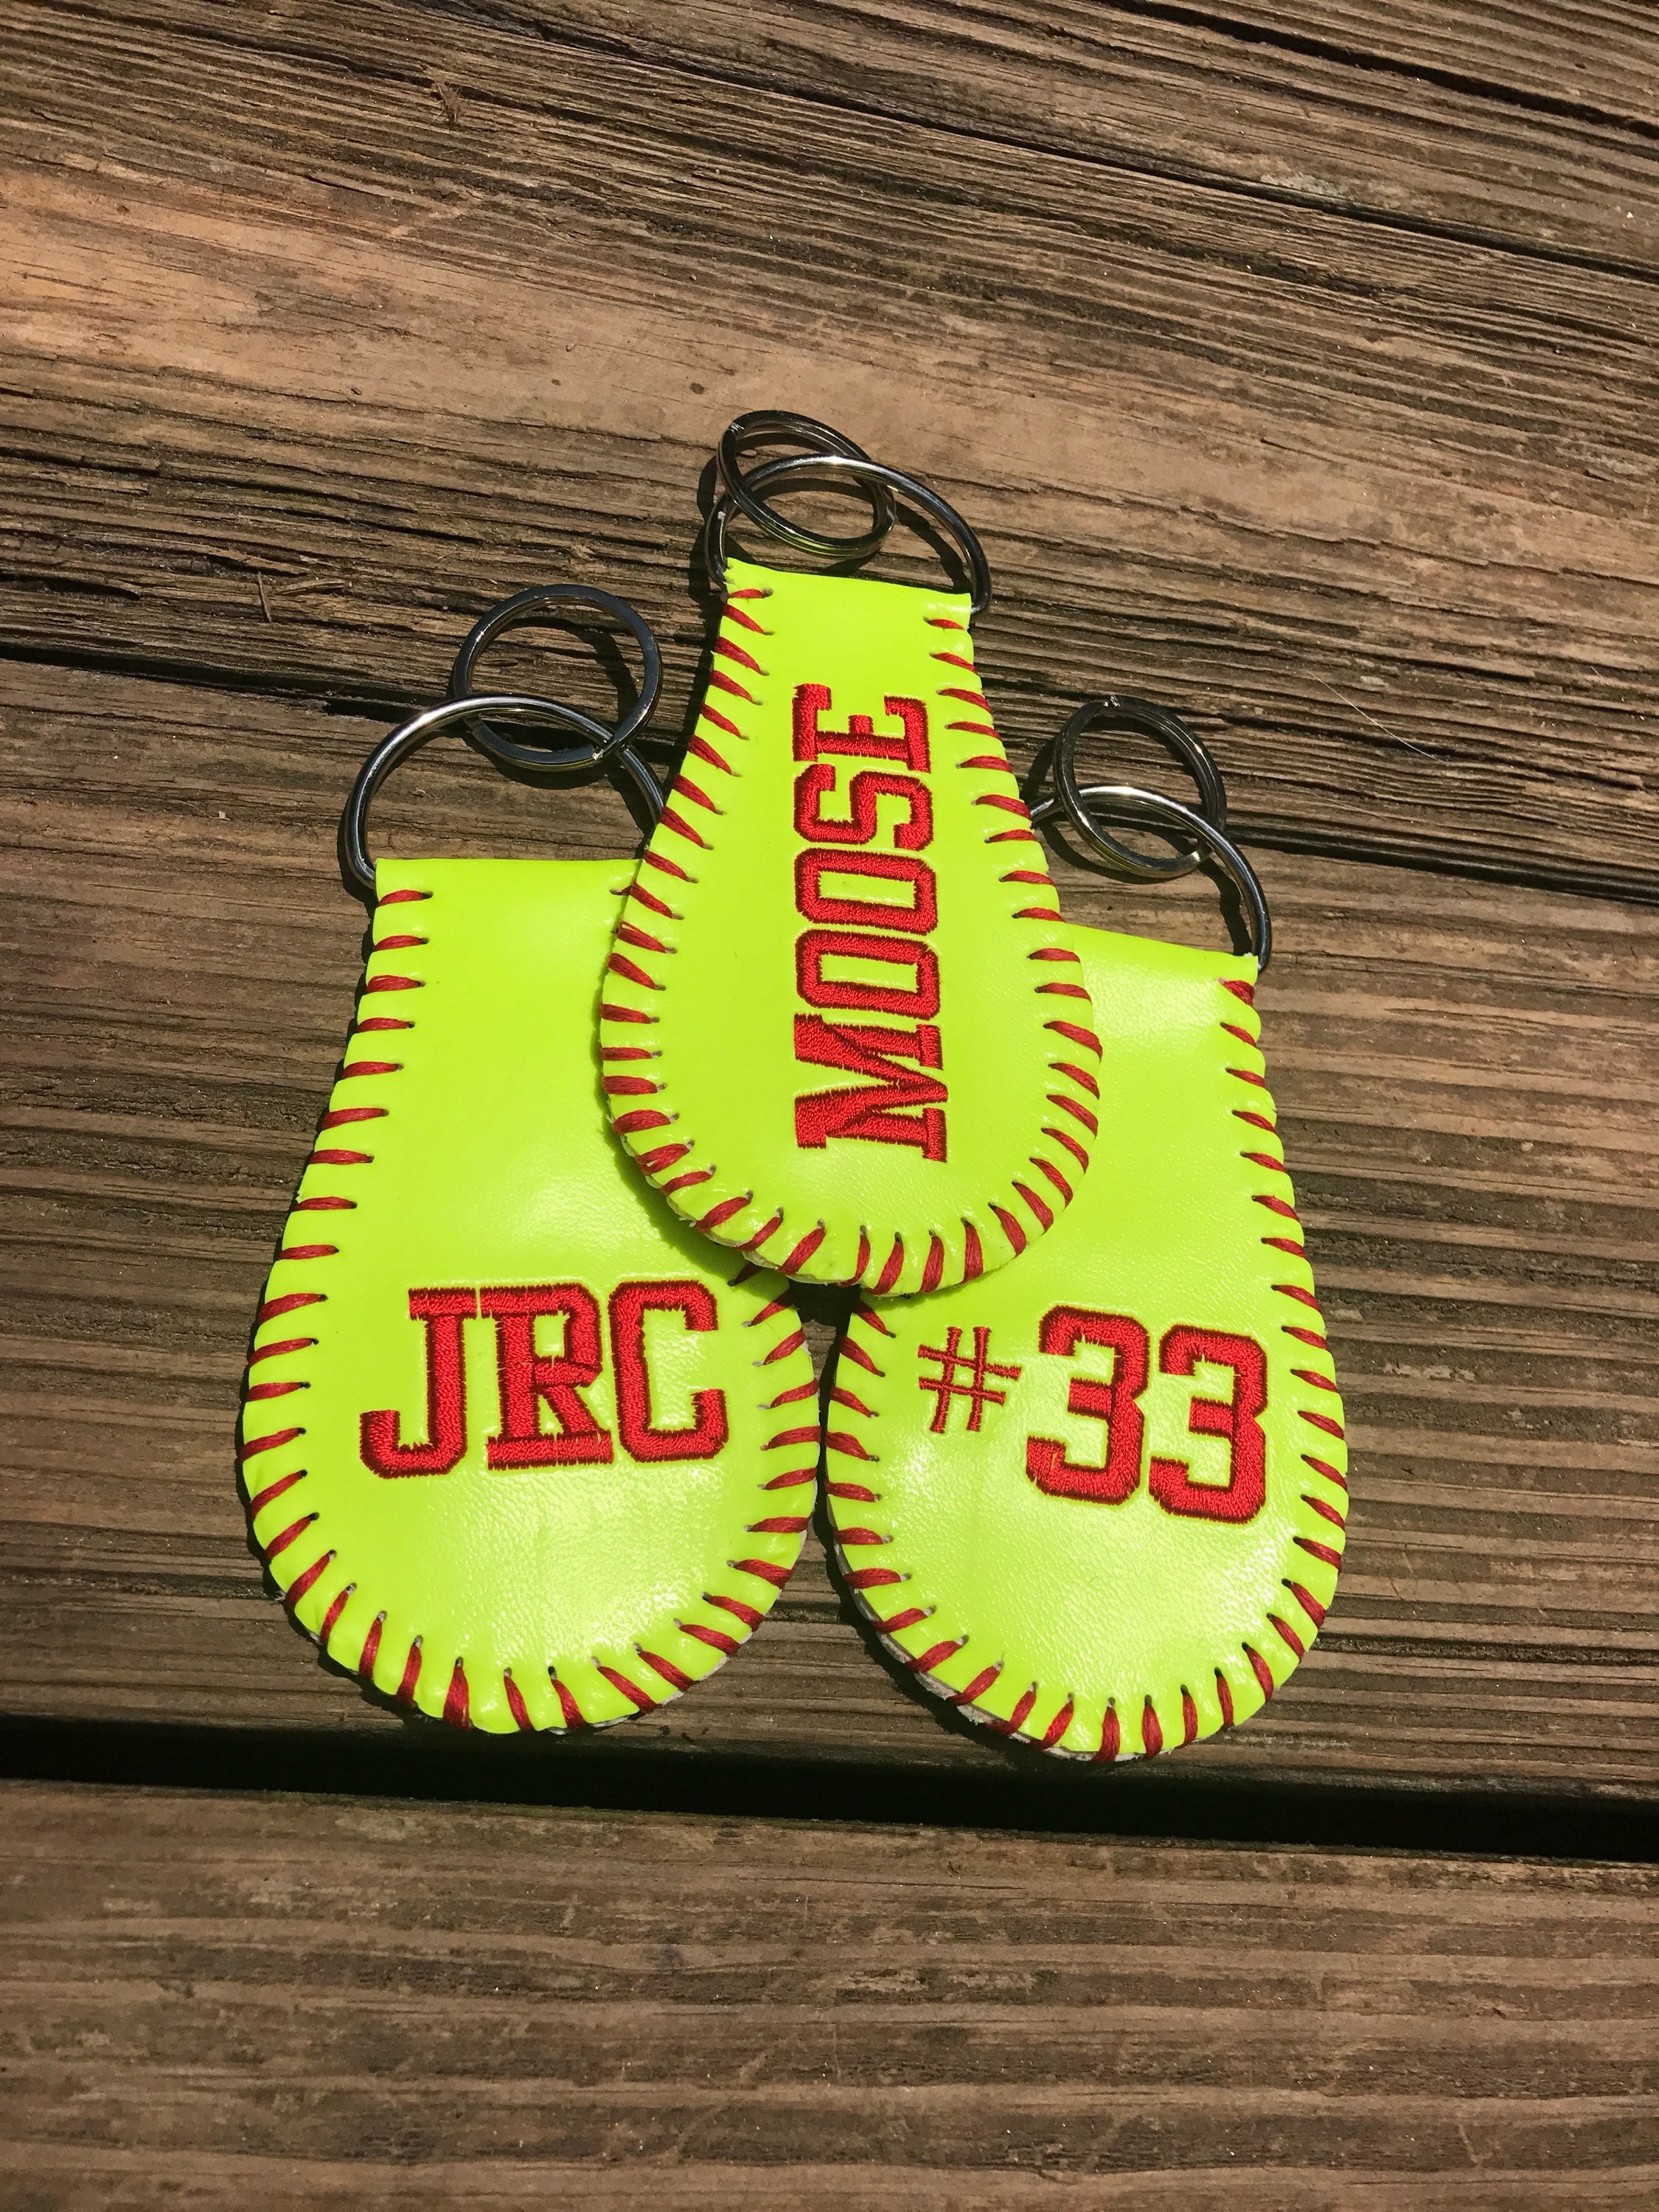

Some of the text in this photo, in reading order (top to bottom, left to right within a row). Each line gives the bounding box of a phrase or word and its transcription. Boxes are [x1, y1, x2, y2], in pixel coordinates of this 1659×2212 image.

[793, 683, 949, 1163] MOOSE
[359, 1279, 728, 1480] JRC
[917, 1304, 1269, 1525] #33
